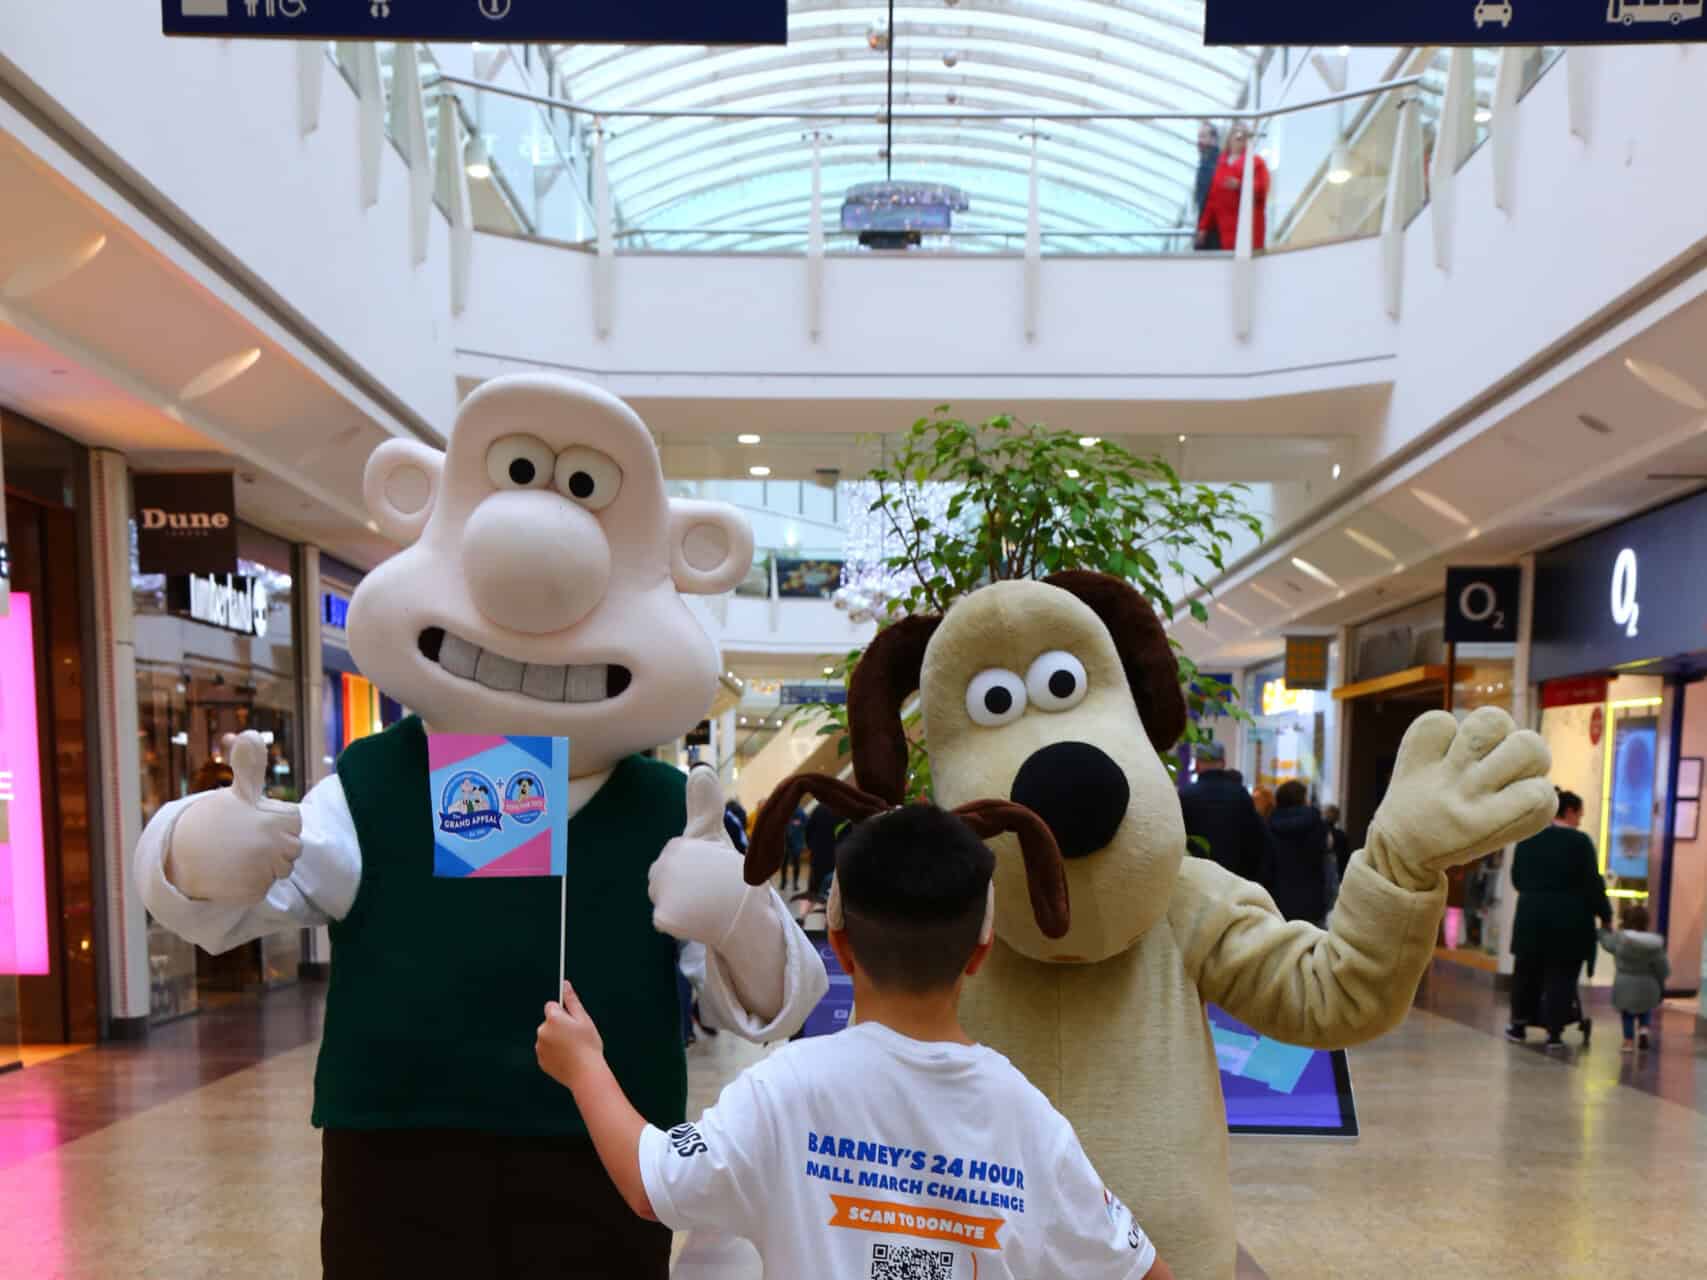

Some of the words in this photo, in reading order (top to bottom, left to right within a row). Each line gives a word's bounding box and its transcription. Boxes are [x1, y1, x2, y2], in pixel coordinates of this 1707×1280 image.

[143, 508, 229, 528] Dune
[444, 818, 471, 829] GRAND
[472, 815, 497, 825] APPEAL
[808, 1131, 926, 1171] BARNEY'S
[931, 1155, 964, 1178] 24
[970, 1160, 1024, 1190] HOUR
[858, 1171, 922, 1195] MARCH
[927, 1182, 1024, 1213] CHALLENGE
[848, 1206, 896, 1225] SCAN
[898, 1212, 913, 1227] TO
[916, 1216, 985, 1240] DONATE
